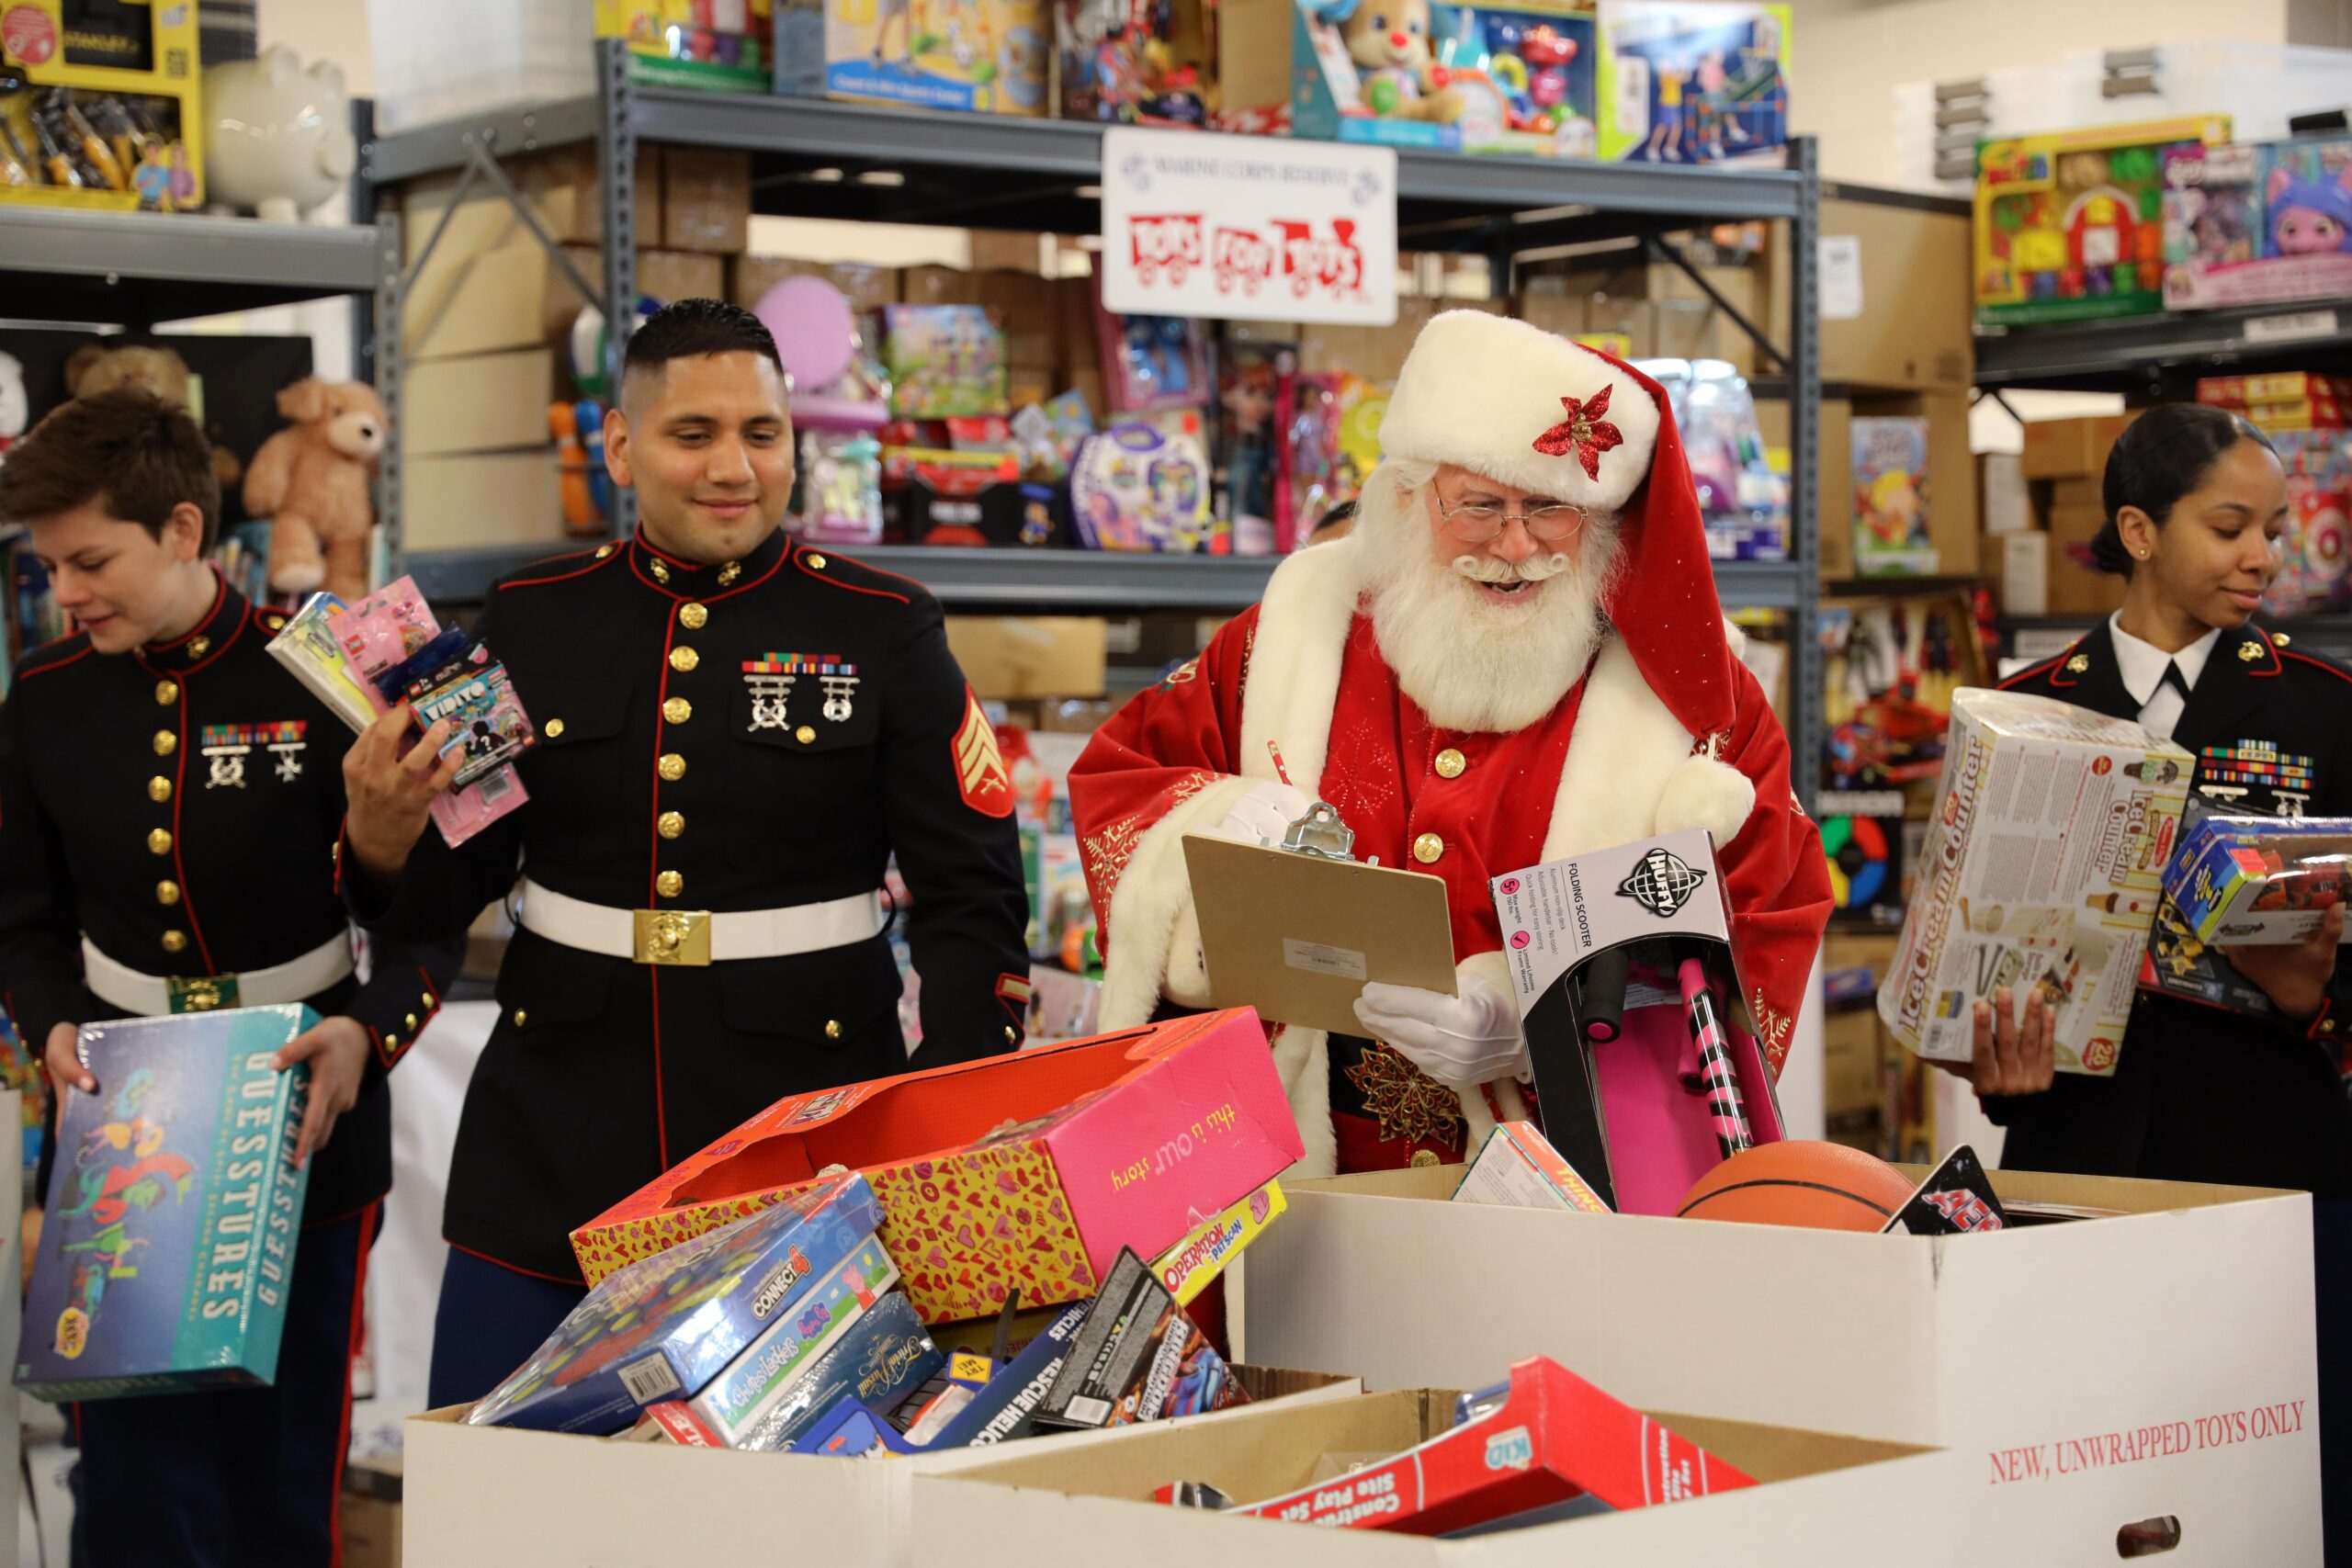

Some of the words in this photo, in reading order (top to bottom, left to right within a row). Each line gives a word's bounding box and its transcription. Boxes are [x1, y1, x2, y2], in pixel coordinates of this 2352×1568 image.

[1132, 219, 1202, 264] TOYS
[1214, 230, 1274, 274] FOR
[424, 680, 487, 722] VIDIYO
[2096, 801, 2128, 873] Counter
[1504, 880, 1515, 893] 5+
[1527, 889, 1536, 908] folding
[1535, 871, 1547, 898] Adjustable
[1542, 898, 1553, 926] handlebar
[1549, 868, 1559, 894] Aluminum
[1554, 895, 1564, 917] non-slip
[1646, 854, 1678, 910] HUFFY
[1567, 863, 1583, 903] FOLDING
[1575, 904, 1592, 948] SCOOTER
[1522, 949, 1531, 969] Limited
[1521, 969, 1529, 994] Warranty
[1526, 970, 1535, 991] Lifetime
[1191, 1122, 1208, 1144] is
[1205, 1103, 1236, 1132] this
[201, 1050, 277, 1320] GUESSTURES
[1110, 1156, 1150, 1191] story
[1163, 1222, 1225, 1293] OPERATION
[752, 1264, 797, 1318] CONNECT
[789, 1244, 811, 1275] 4
[1046, 1298, 1093, 1342] VEHICLES
[732, 1369, 768, 1407] Chutes
[760, 1336, 799, 1378] Ladders
[956, 1355, 978, 1371] ME!
[965, 1364, 986, 1378] TRY
[1012, 1358, 1067, 1413] RESCUE
[1486, 1434, 1532, 1469] KID
[1988, 1445, 2051, 1485] NEW,
[2054, 1420, 2192, 1474] UNWRAPPED
[2193, 1410, 2247, 1450] TOYS
[2249, 1399, 2306, 1440] ONLY
[1311, 1485, 1356, 1512] Play
[1355, 1472, 1397, 1499] Site
